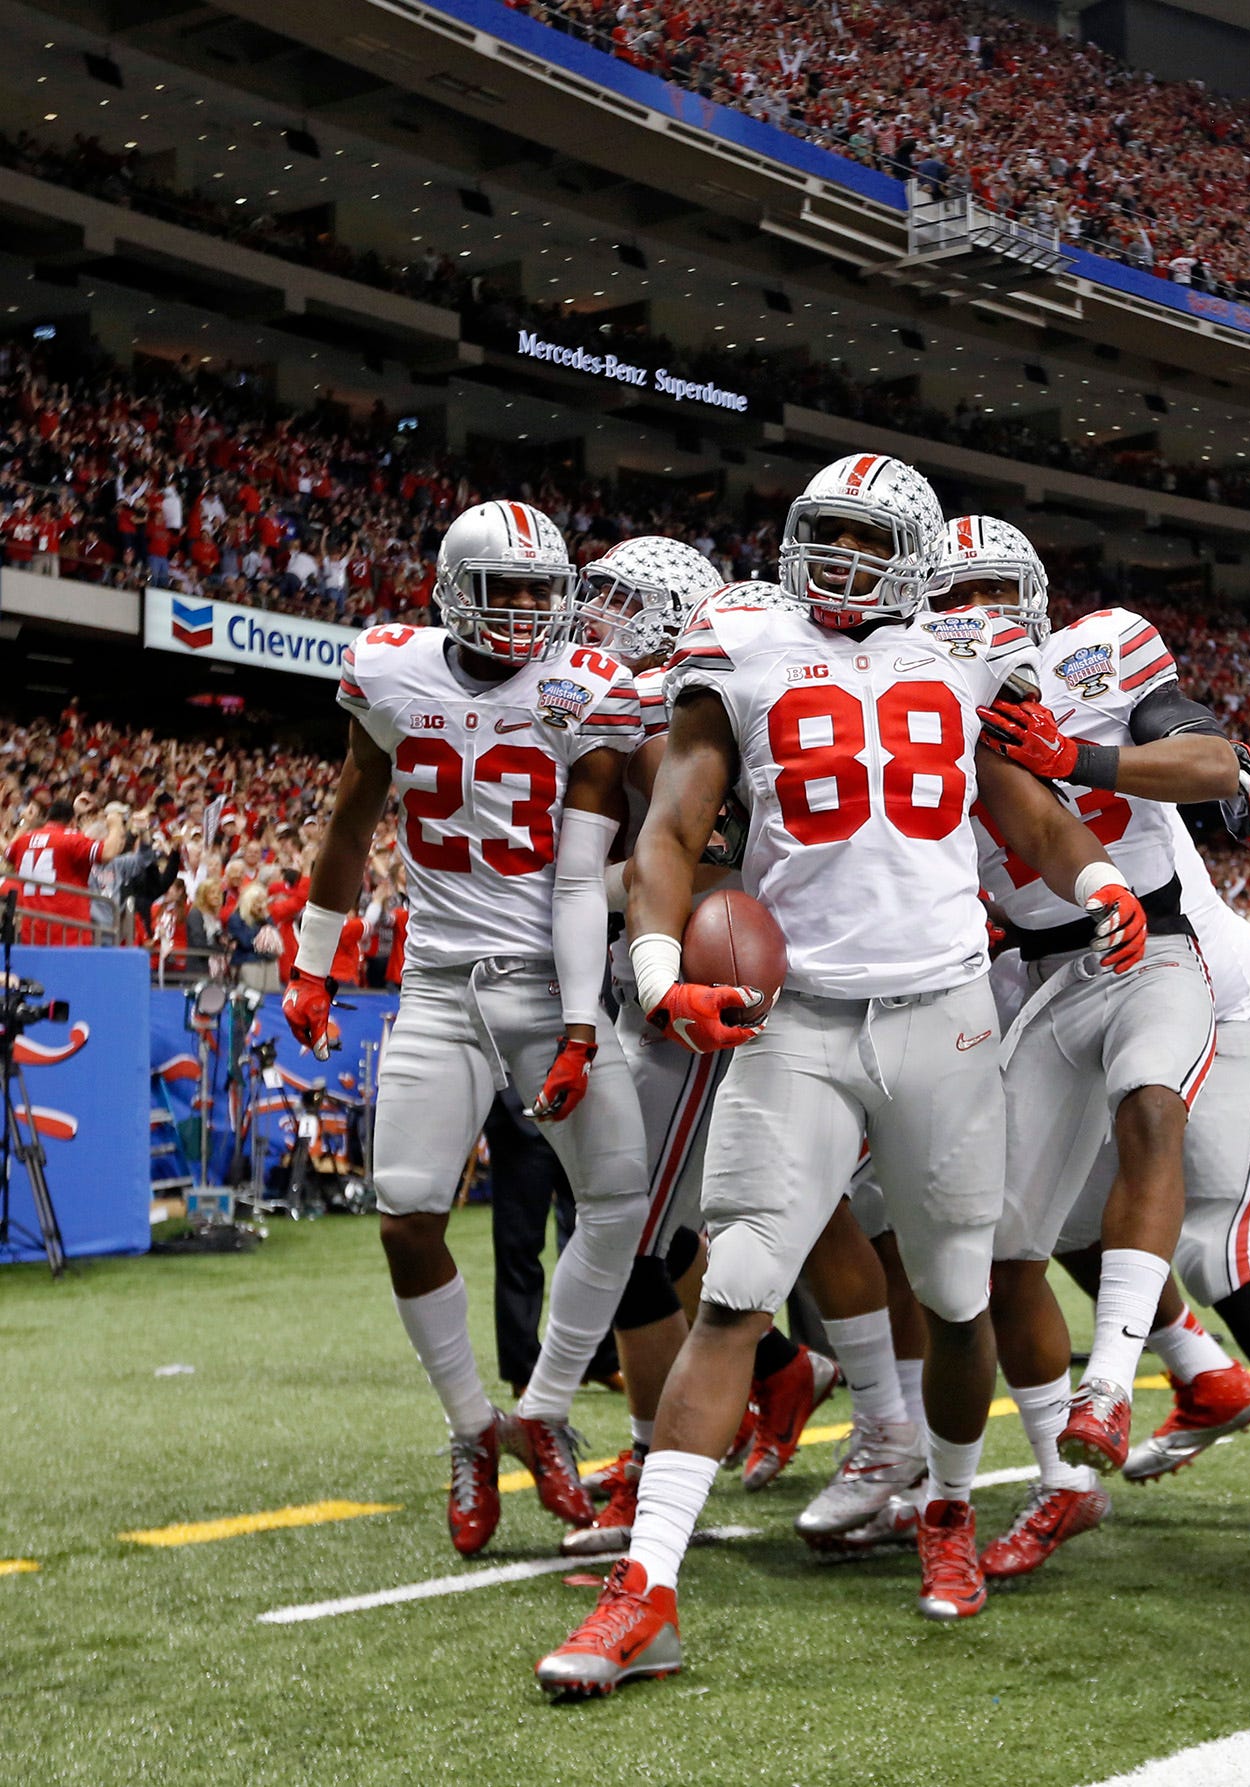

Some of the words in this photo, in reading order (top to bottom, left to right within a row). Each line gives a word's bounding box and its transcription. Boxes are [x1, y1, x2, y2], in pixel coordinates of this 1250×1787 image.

[517, 329, 648, 387] Mercedes-Benz
[654, 368, 748, 413] Superdome
[396, 736, 556, 876] 23
[767, 681, 966, 846] 88
